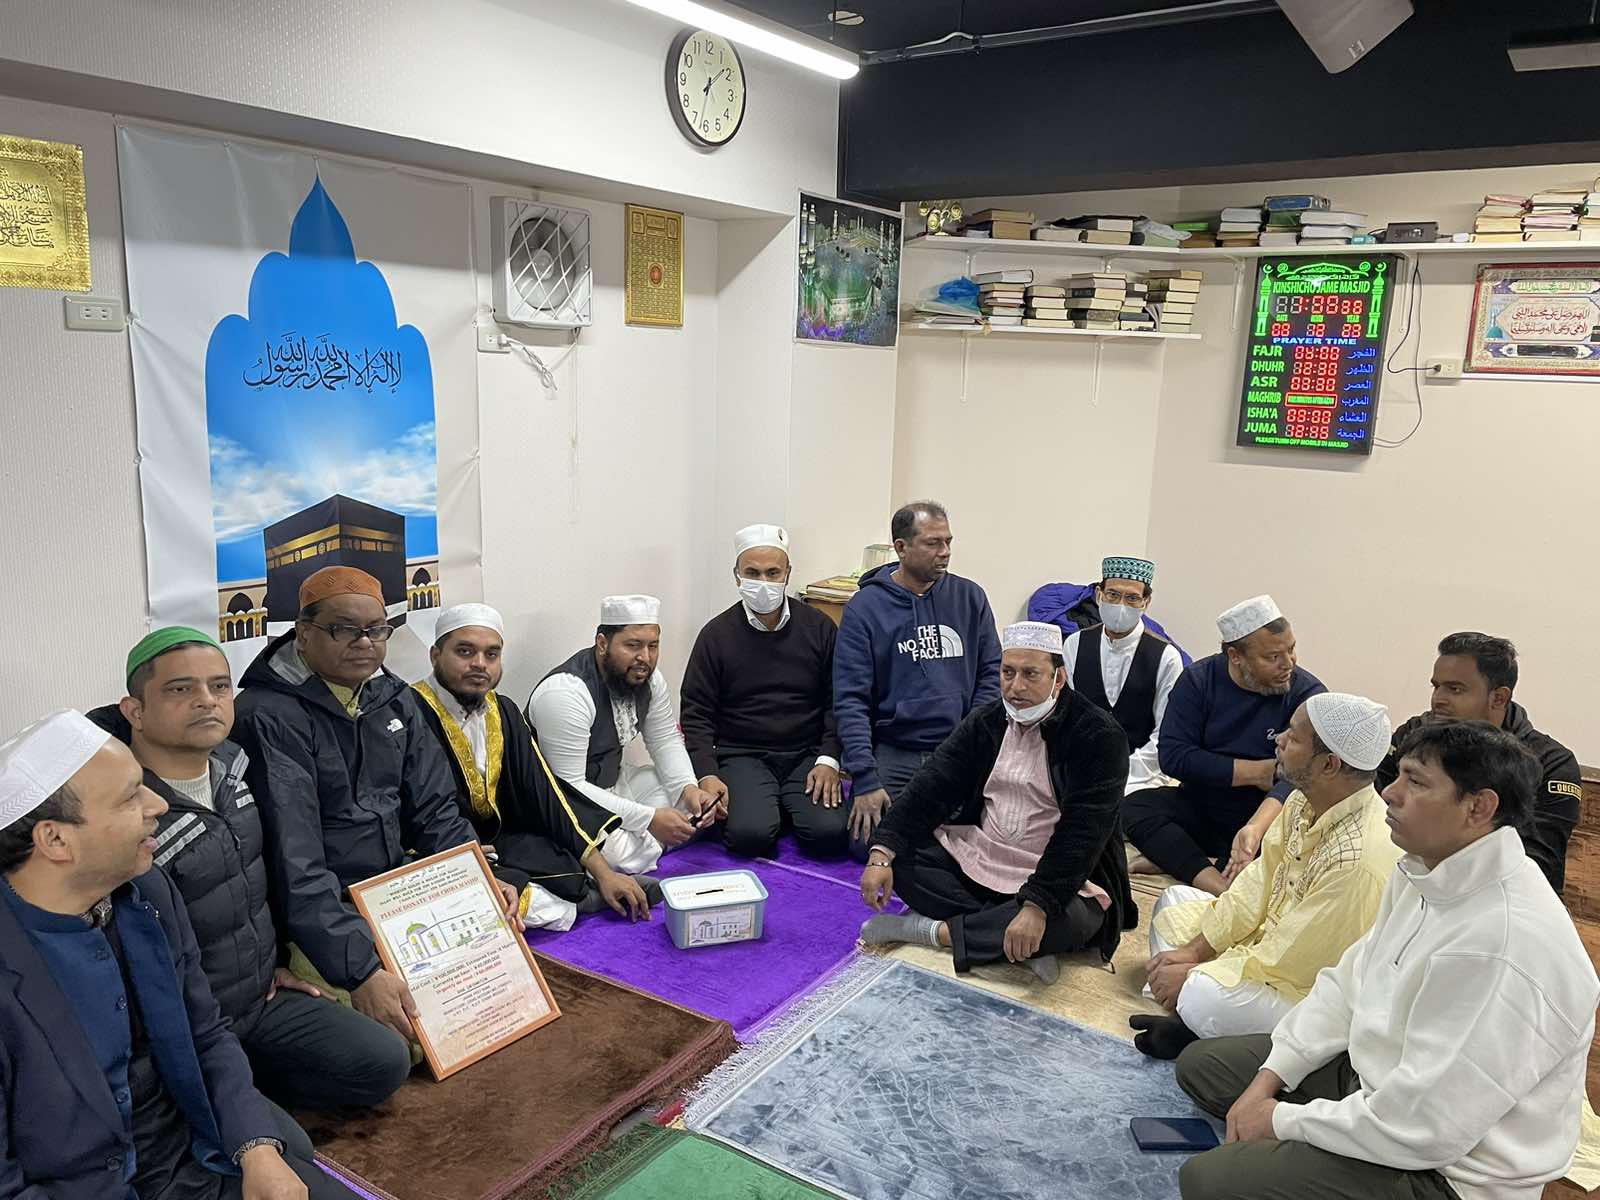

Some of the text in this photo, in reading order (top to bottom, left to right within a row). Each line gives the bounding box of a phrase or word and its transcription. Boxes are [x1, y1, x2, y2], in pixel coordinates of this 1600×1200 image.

[693, 41, 700, 56] 11
[705, 40, 714, 55] 12
[684, 53, 693, 68] 10
[719, 51, 723, 64] 1
[680, 72, 686, 86] 9
[725, 68, 731, 81] 2
[683, 94, 689, 107] 8
[728, 88, 734, 102] 3
[692, 111, 698, 124] 7
[723, 108, 729, 120] 4
[703, 120, 709, 133] 6
[715, 119, 721, 131] 5
[1273, 281, 1370, 293] KINSHICHO JAME MASJID
[1253, 345, 1282, 356] FAJR
[1252, 361, 1285, 372] DHUHR
[1251, 377, 1277, 387] ASR
[1247, 391, 1281, 404] MAGHRIB
[1247, 408, 1278, 419] ISHA'A
[1244, 422, 1277, 434] JUMA
[917, 625, 938, 638] THE
[898, 636, 939, 654] NORTH
[912, 647, 941, 661] FACE
